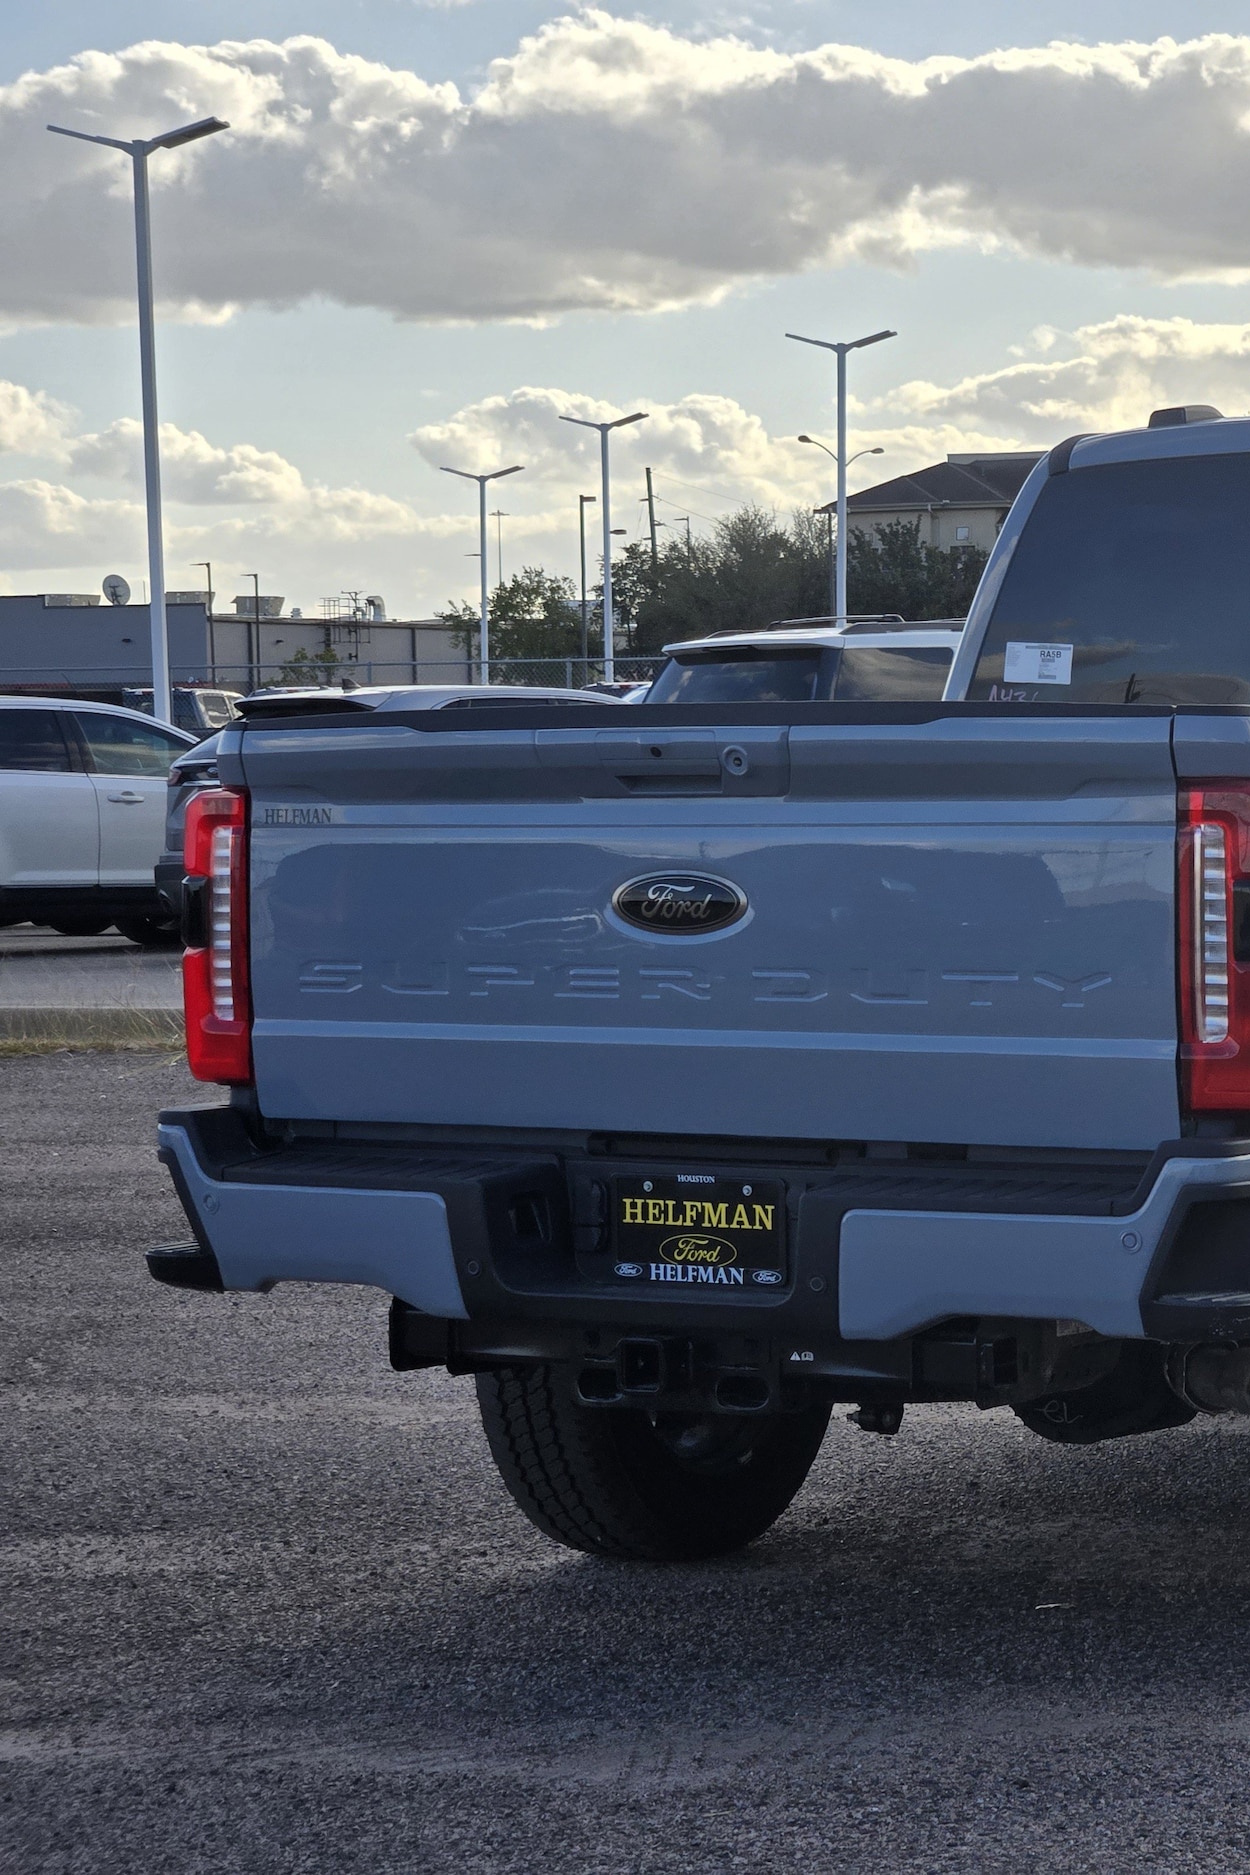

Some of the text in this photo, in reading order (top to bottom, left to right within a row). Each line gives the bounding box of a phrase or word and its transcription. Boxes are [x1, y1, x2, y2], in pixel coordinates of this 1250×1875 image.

[264, 808, 332, 824] HELFMAN
[641, 883, 712, 918] Ford
[299, 958, 1113, 1006] SUPER DUTY
[677, 1174, 715, 1183] HOUSTON
[622, 1198, 775, 1230] HELFMAN
[673, 1237, 721, 1262] Ford
[650, 1263, 744, 1285] HELFMAN
